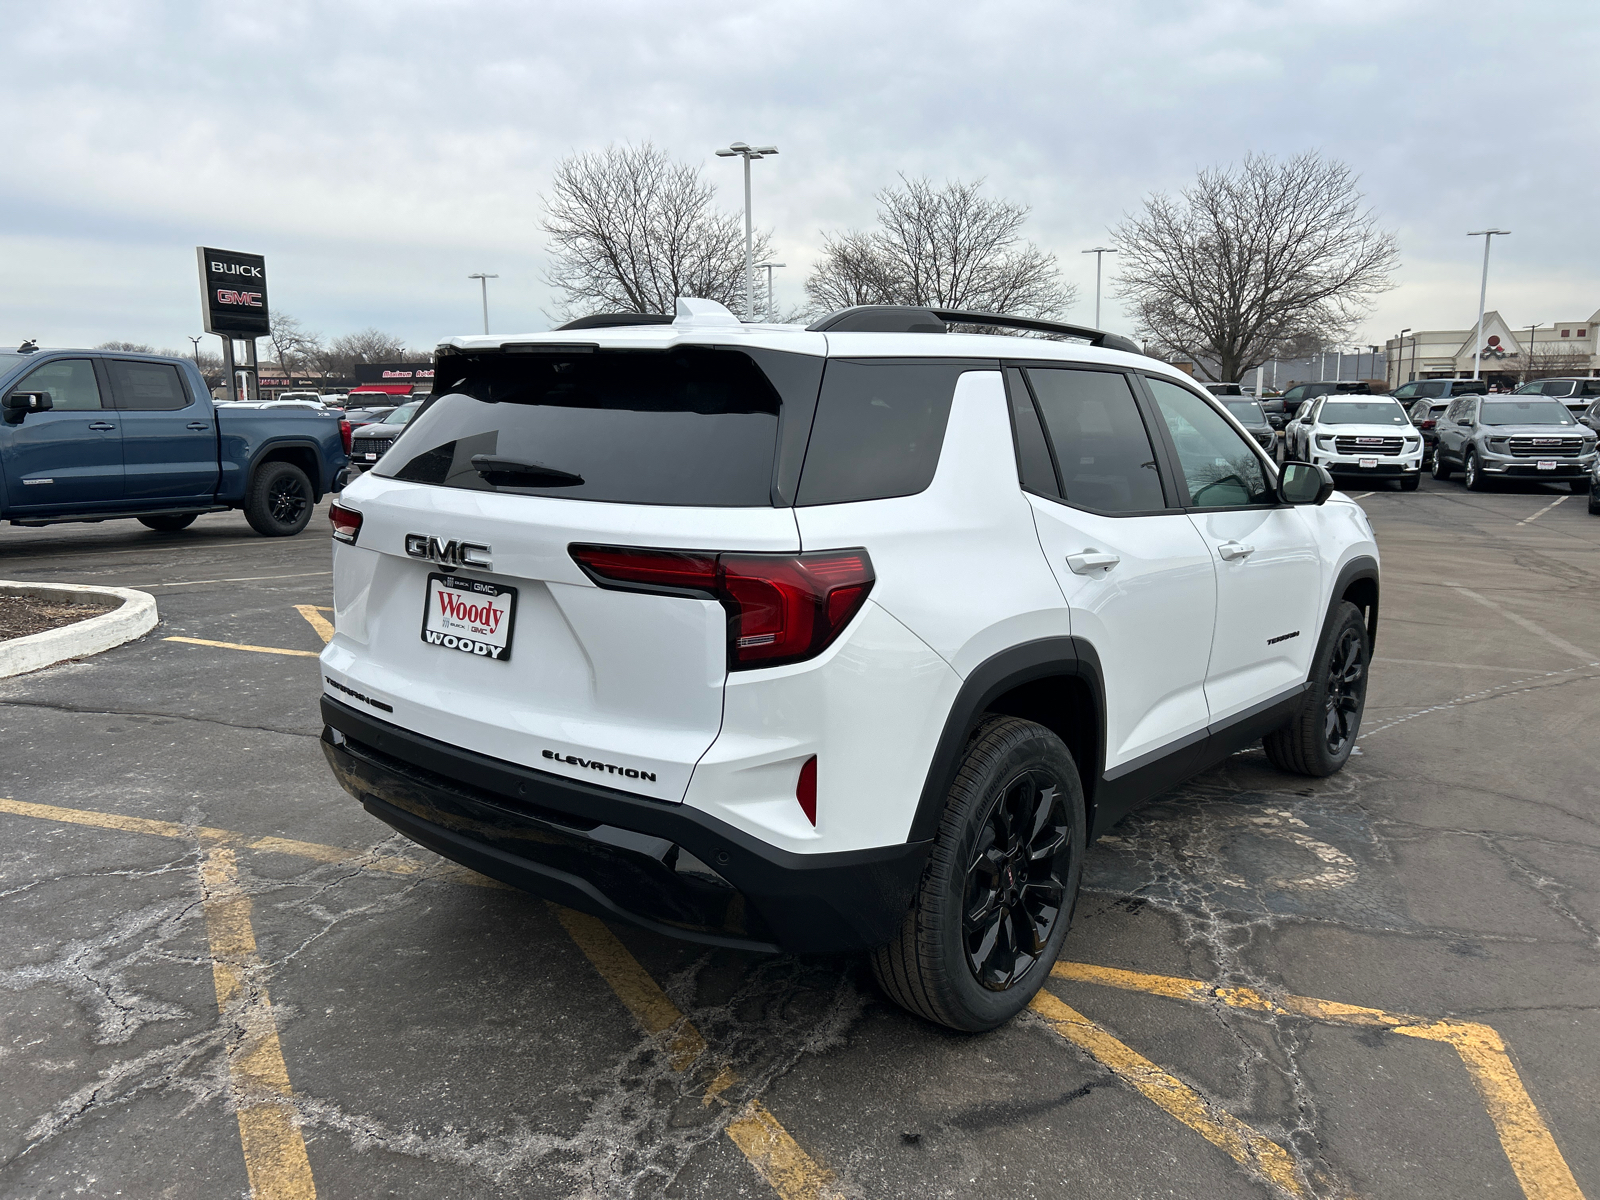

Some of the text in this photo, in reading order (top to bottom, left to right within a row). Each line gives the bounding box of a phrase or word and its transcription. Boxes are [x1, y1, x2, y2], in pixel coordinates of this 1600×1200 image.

[211, 261, 262, 277] BUICK
[217, 289, 262, 307] GMC
[405, 532, 493, 571] GMC
[473, 583, 494, 593] GMC
[437, 590, 504, 634] Woody
[470, 626, 487, 635] GMC
[425, 630, 502, 659] WOODY
[541, 749, 656, 782] ELEVATION
